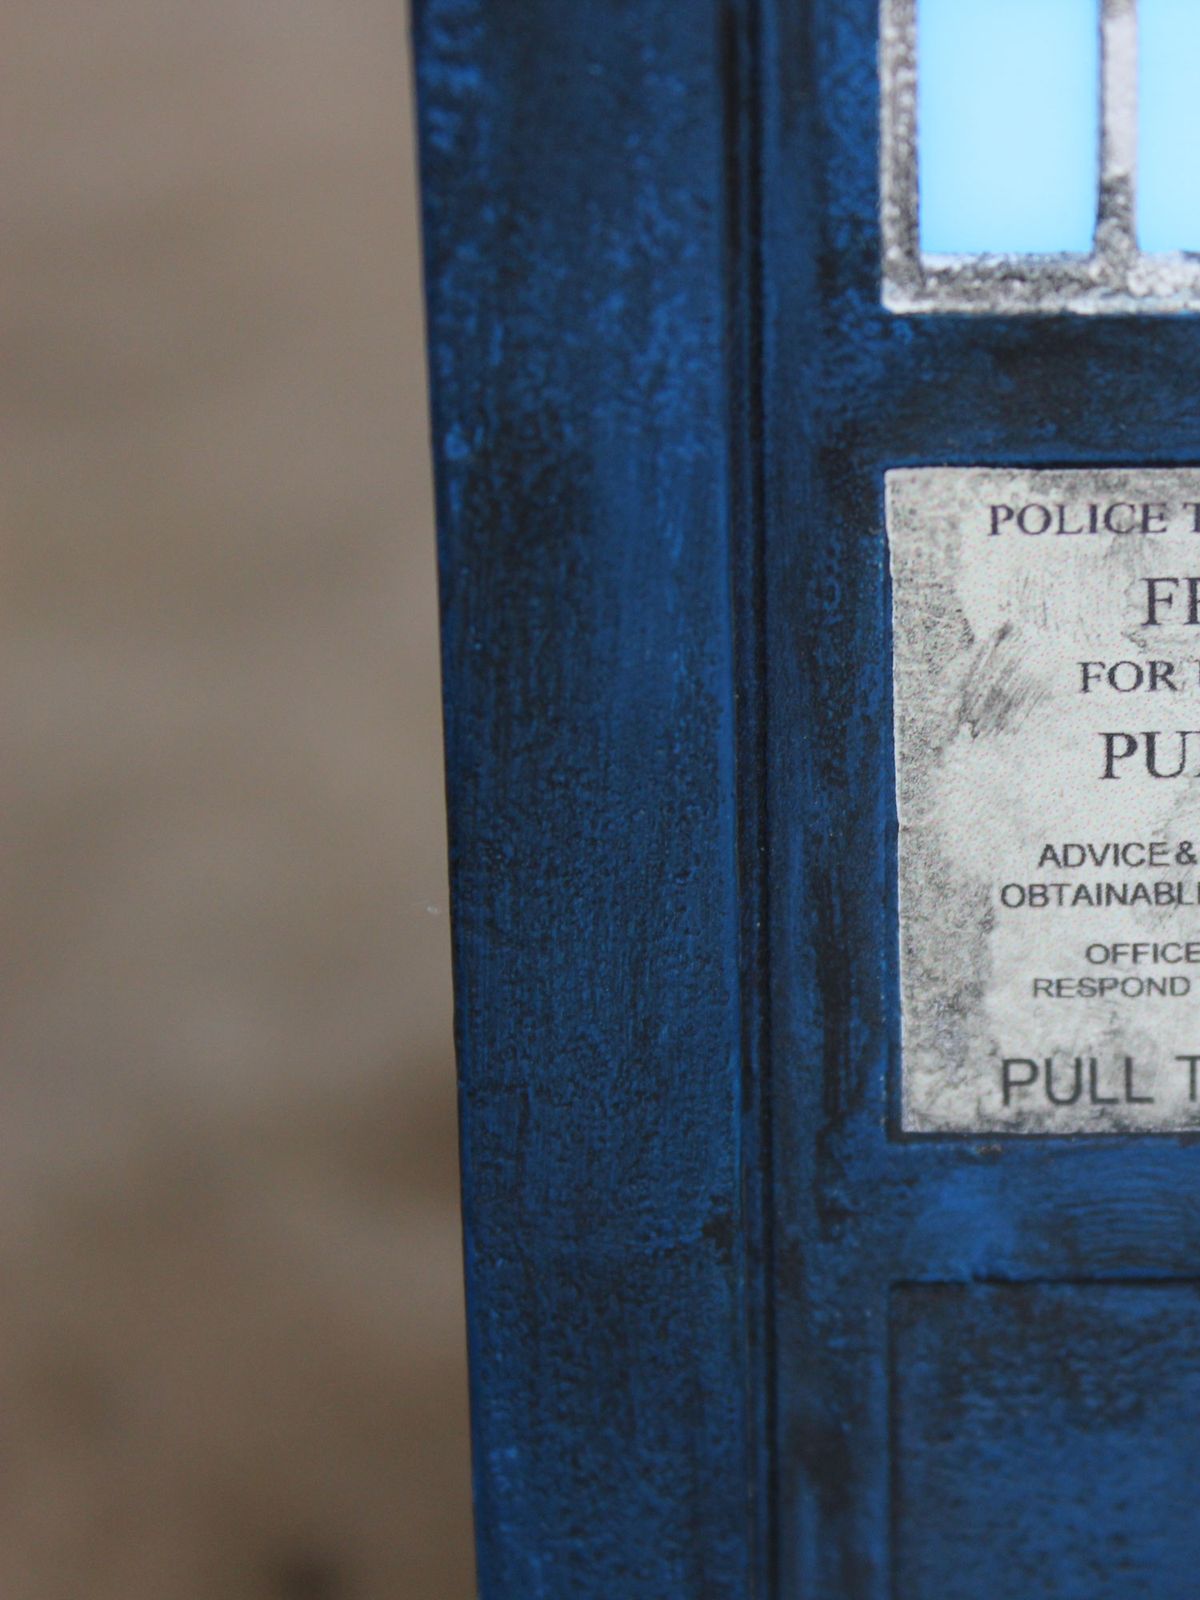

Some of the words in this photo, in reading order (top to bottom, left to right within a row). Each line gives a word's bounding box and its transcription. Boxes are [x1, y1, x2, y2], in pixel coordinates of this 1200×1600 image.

[987, 503, 1168, 537] POLICE
[1078, 660, 1179, 694] FOR
[1036, 842, 1169, 870] ADVICE
[1174, 841, 1197, 865] &
[1031, 976, 1191, 1000] RESPOND
[998, 1057, 1154, 1106] PULL
